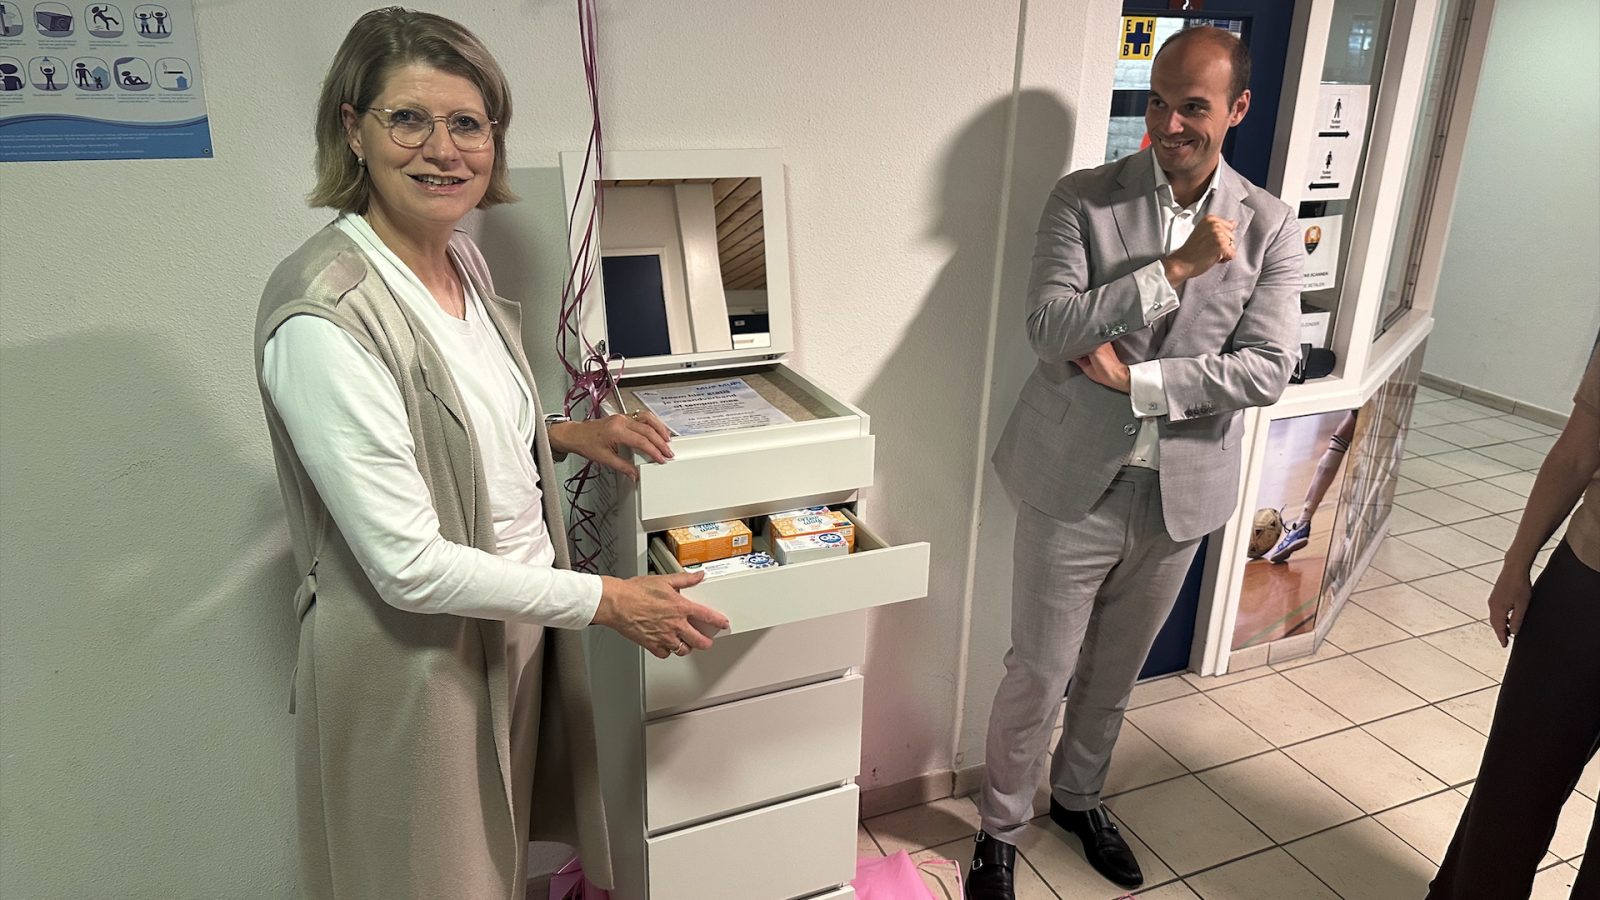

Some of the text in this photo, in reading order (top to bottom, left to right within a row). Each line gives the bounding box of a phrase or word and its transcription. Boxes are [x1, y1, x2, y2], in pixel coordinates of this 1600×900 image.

[1126, 20, 1154, 32] E H
[1123, 44, 1150, 56] B O
